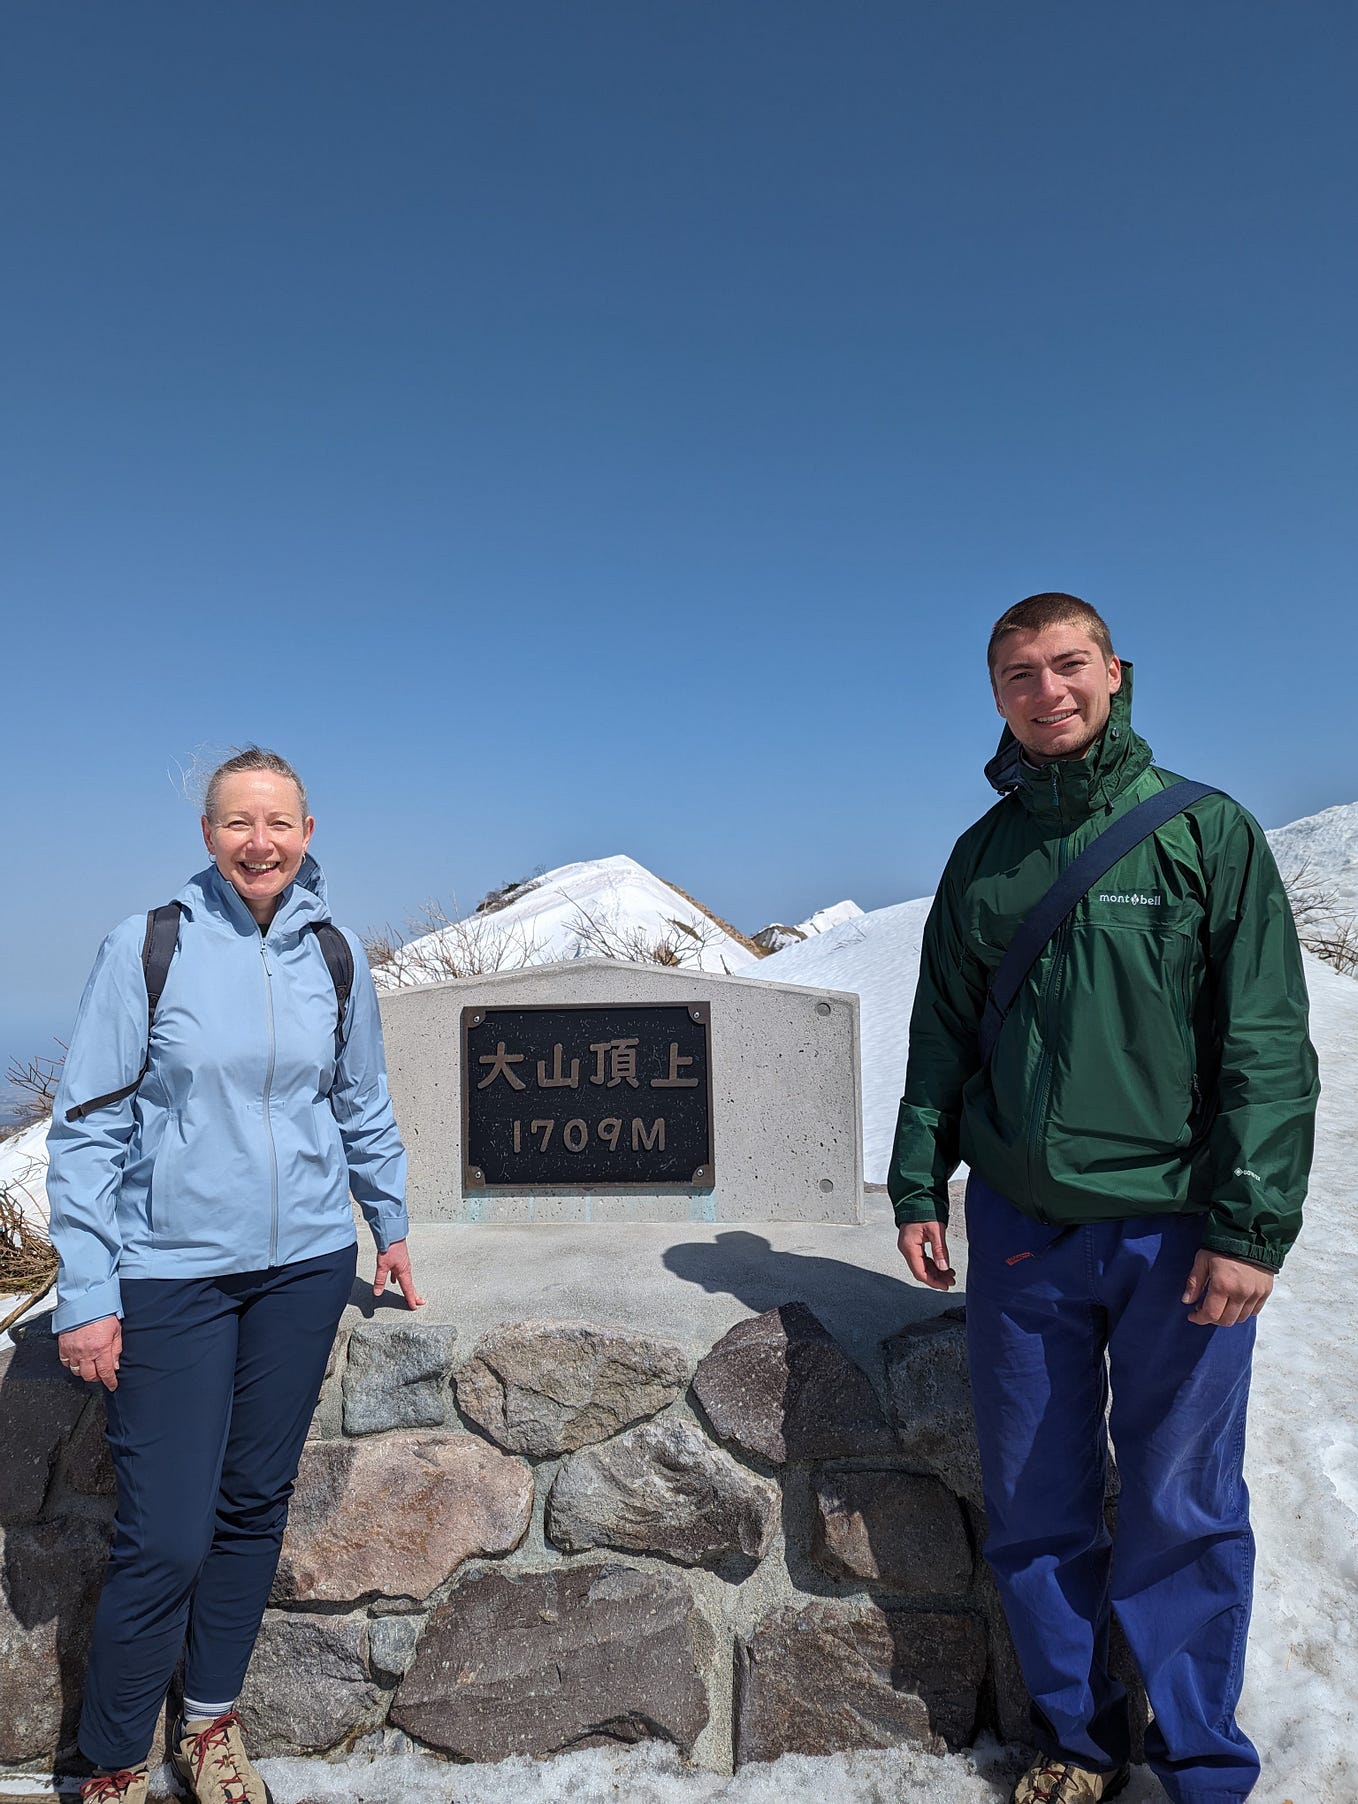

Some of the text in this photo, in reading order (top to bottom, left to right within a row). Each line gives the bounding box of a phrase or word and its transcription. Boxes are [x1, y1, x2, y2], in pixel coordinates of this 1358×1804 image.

[477, 1038, 699, 1090] 大山頂上
[512, 1117, 666, 1153] 1709M
